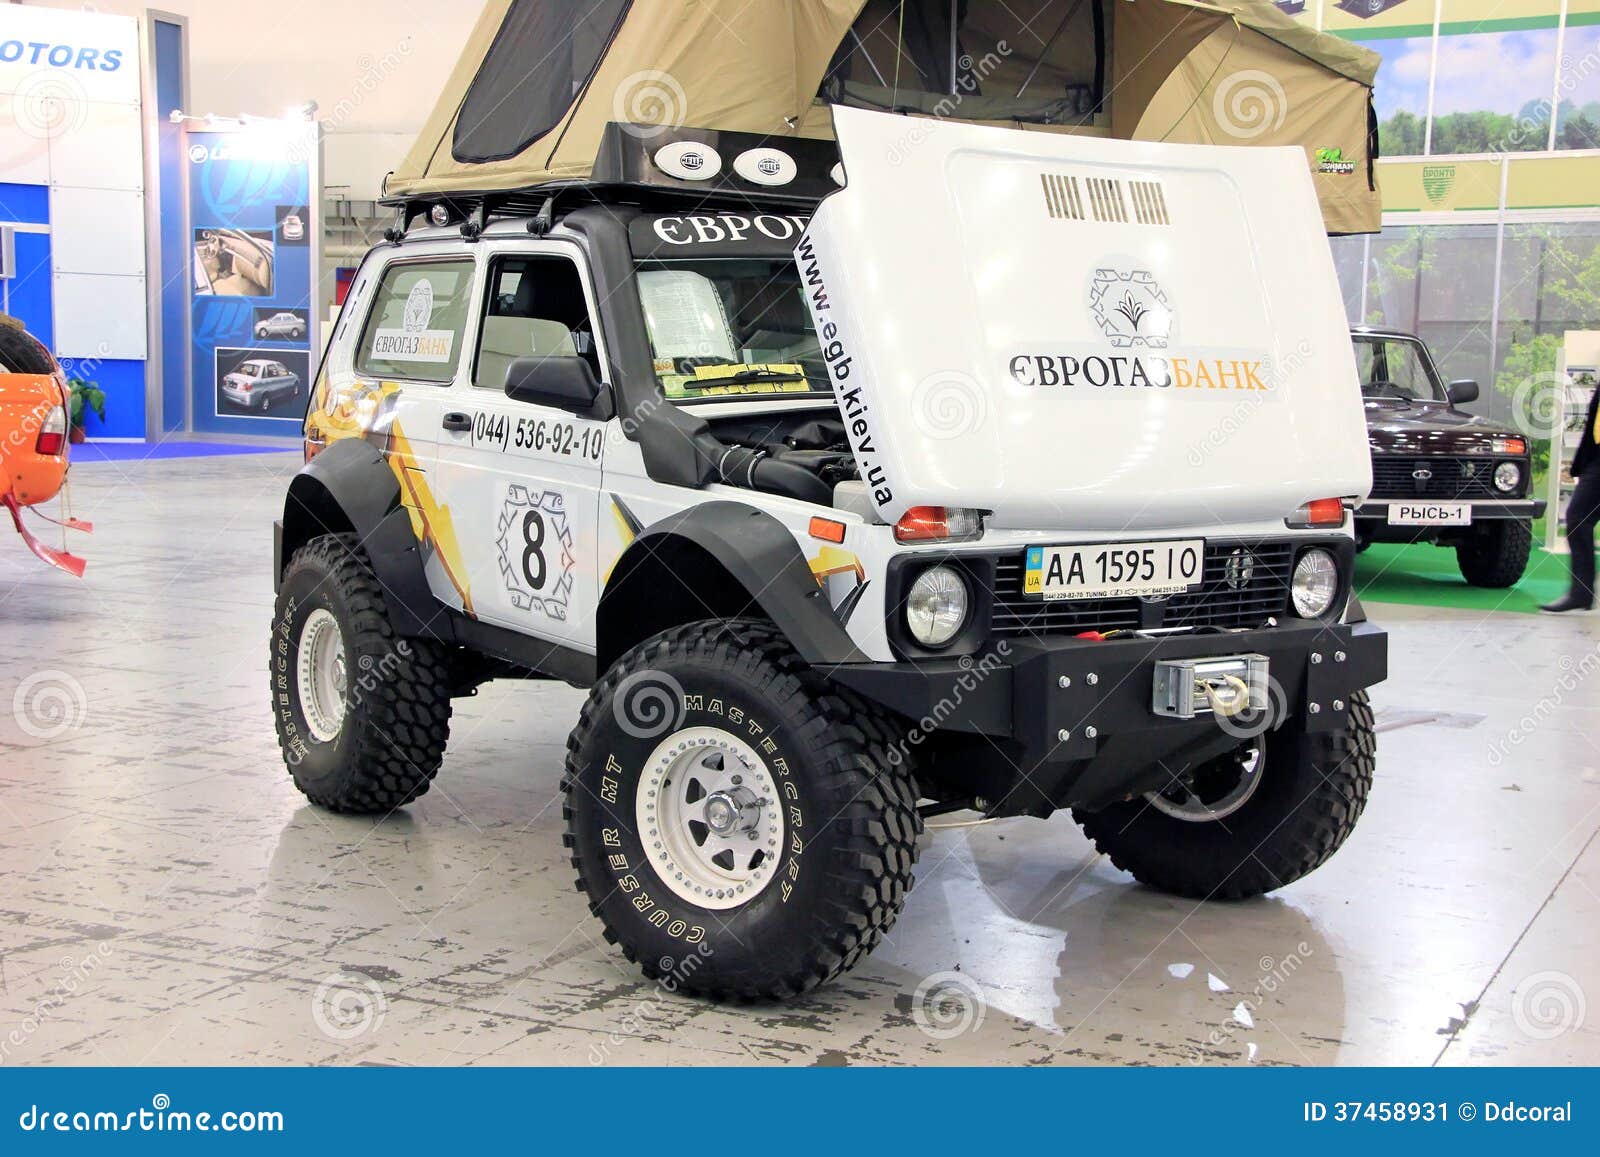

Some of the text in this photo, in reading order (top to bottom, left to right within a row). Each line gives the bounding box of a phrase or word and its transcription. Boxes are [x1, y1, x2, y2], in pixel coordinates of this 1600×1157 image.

[0, 40, 122, 71] OTORS
[375, 335, 450, 356] ЄВРОГАЗБАНК
[798, 235, 894, 507] www.egb.kiev.ua
[1009, 354, 1268, 391] ЄВРОГАЗБАНК
[471, 411, 603, 460] (044) 536-92-10
[1400, 507, 1462, 519] РЫСЬ-1
[521, 510, 547, 590] 8
[1045, 552, 1085, 586] AA
[1095, 549, 1155, 583] 1595
[1027, 577, 1040, 586] UA
[684, 695, 803, 903] MASTERCRAFT
[600, 754, 705, 944] COURSER MT
